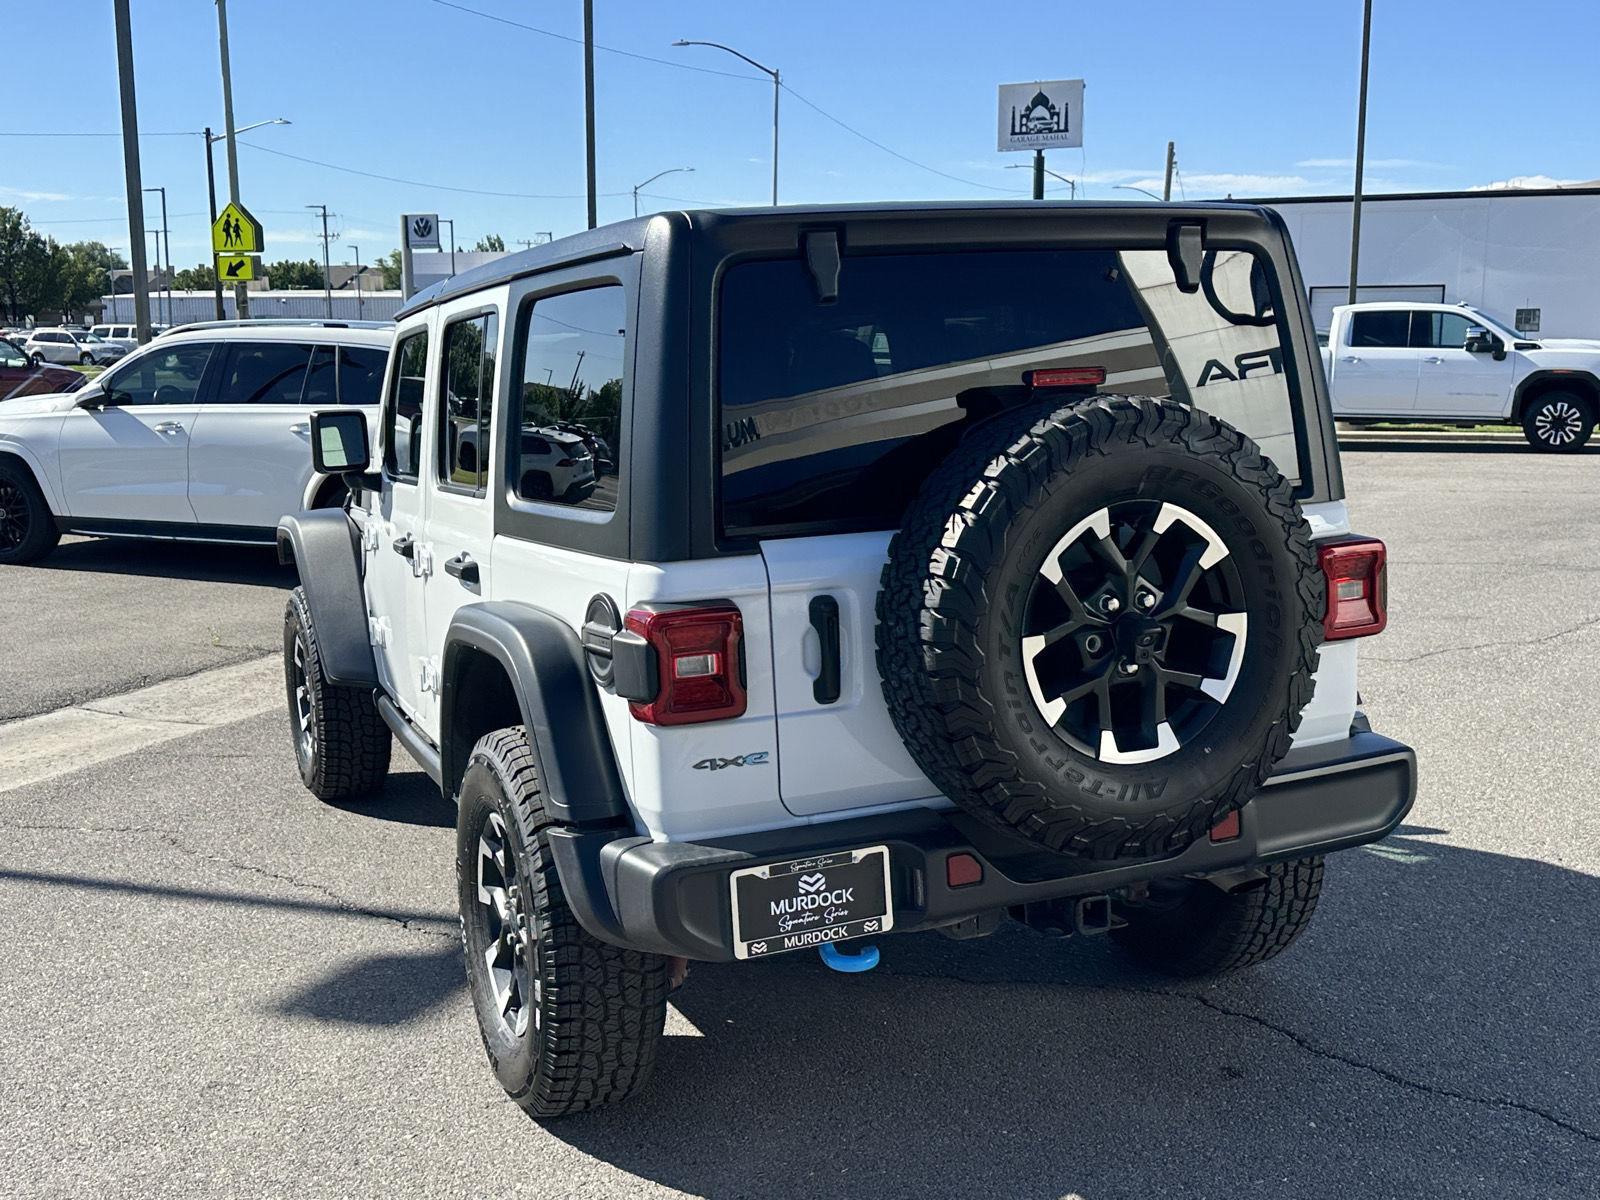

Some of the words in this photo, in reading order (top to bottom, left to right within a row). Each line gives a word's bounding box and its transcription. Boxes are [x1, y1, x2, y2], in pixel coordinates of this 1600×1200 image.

[1010, 135, 1040, 143] GARAGE
[1042, 133, 1069, 141] MAHAL
[790, 860, 816, 873] Signature
[817, 857, 834, 868] Series
[770, 887, 854, 916] MURDOCK
[778, 912, 820, 933] Signature
[823, 906, 849, 925] Series
[784, 926, 848, 949] MURDOCK
